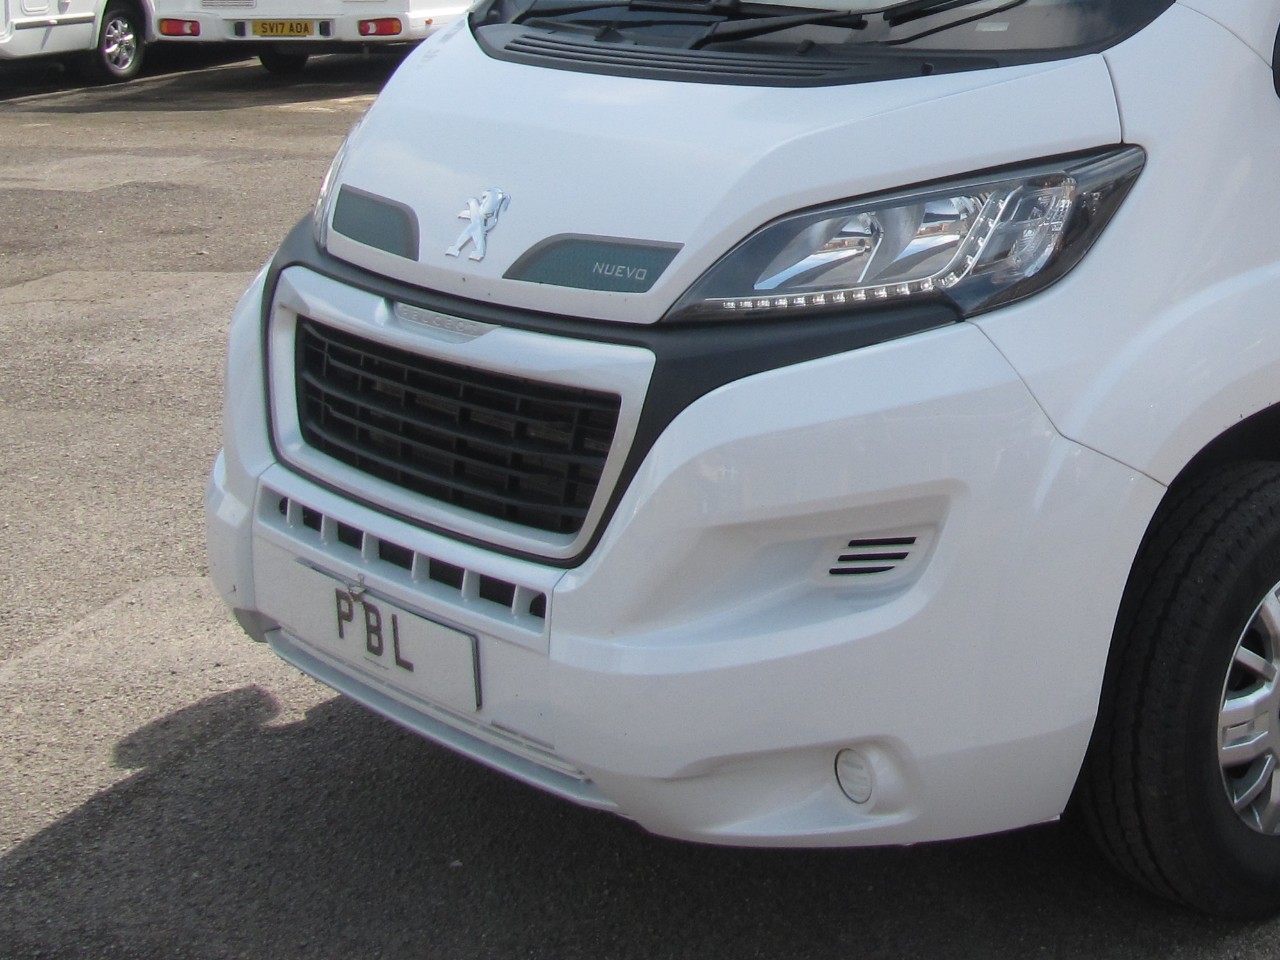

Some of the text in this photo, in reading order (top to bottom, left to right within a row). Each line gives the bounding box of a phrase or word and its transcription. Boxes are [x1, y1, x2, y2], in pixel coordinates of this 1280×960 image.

[261, 22, 310, 34] SV17 AOA
[592, 261, 648, 281] NUEVO
[335, 587, 414, 673] PBL
